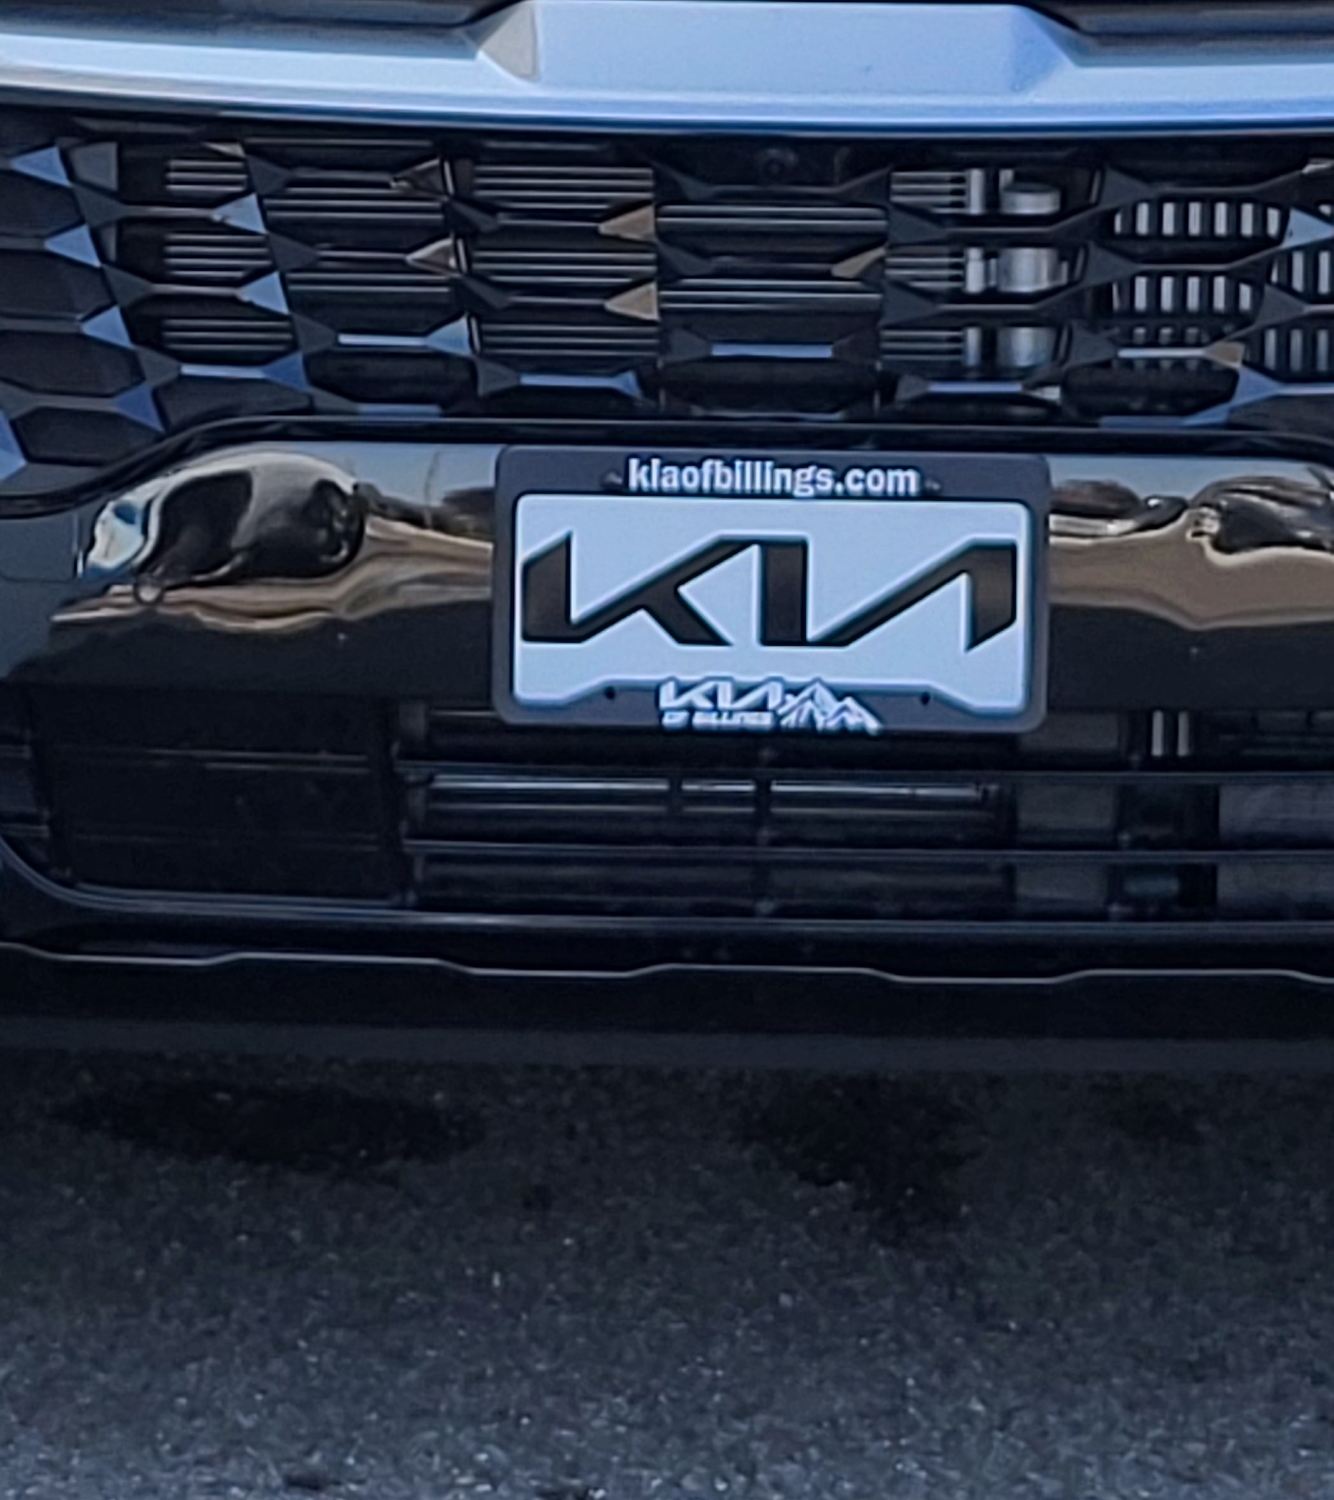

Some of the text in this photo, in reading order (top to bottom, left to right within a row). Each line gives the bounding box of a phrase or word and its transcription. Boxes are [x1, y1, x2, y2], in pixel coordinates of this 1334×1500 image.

[628, 457, 919, 498] kiaofbillings.com
[522, 533, 1017, 651] KIA
[659, 680, 783, 710] KIA
